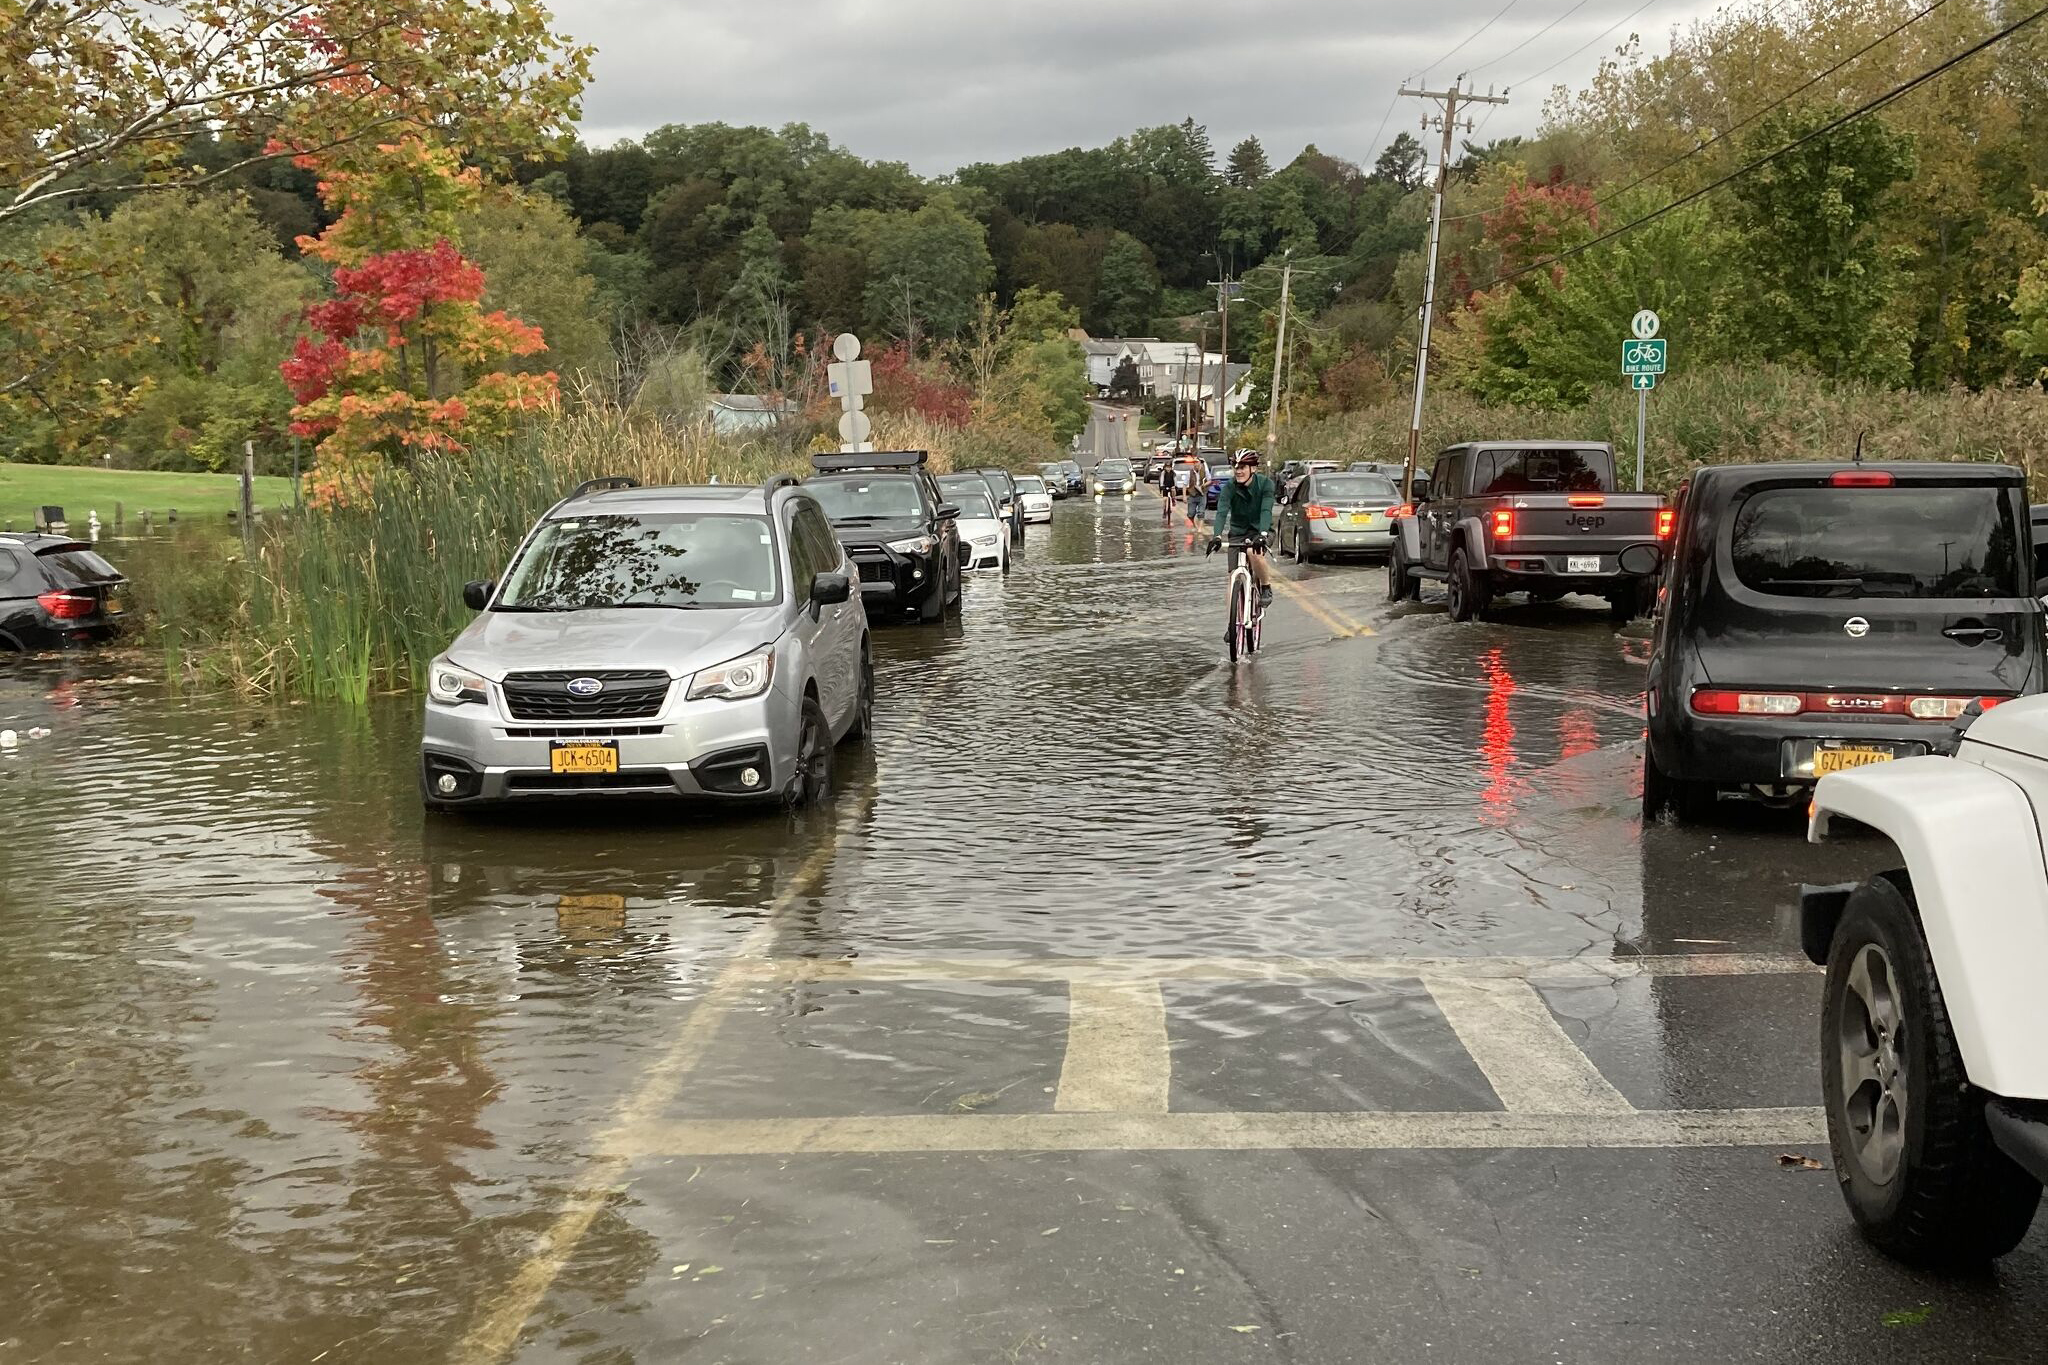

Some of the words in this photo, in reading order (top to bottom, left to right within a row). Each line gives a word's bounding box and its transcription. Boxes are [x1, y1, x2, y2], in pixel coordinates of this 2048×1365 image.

[1641, 364, 1662, 372] ROUTE
[1566, 513, 1605, 528] Jeep
[1826, 697, 1885, 708] cube
